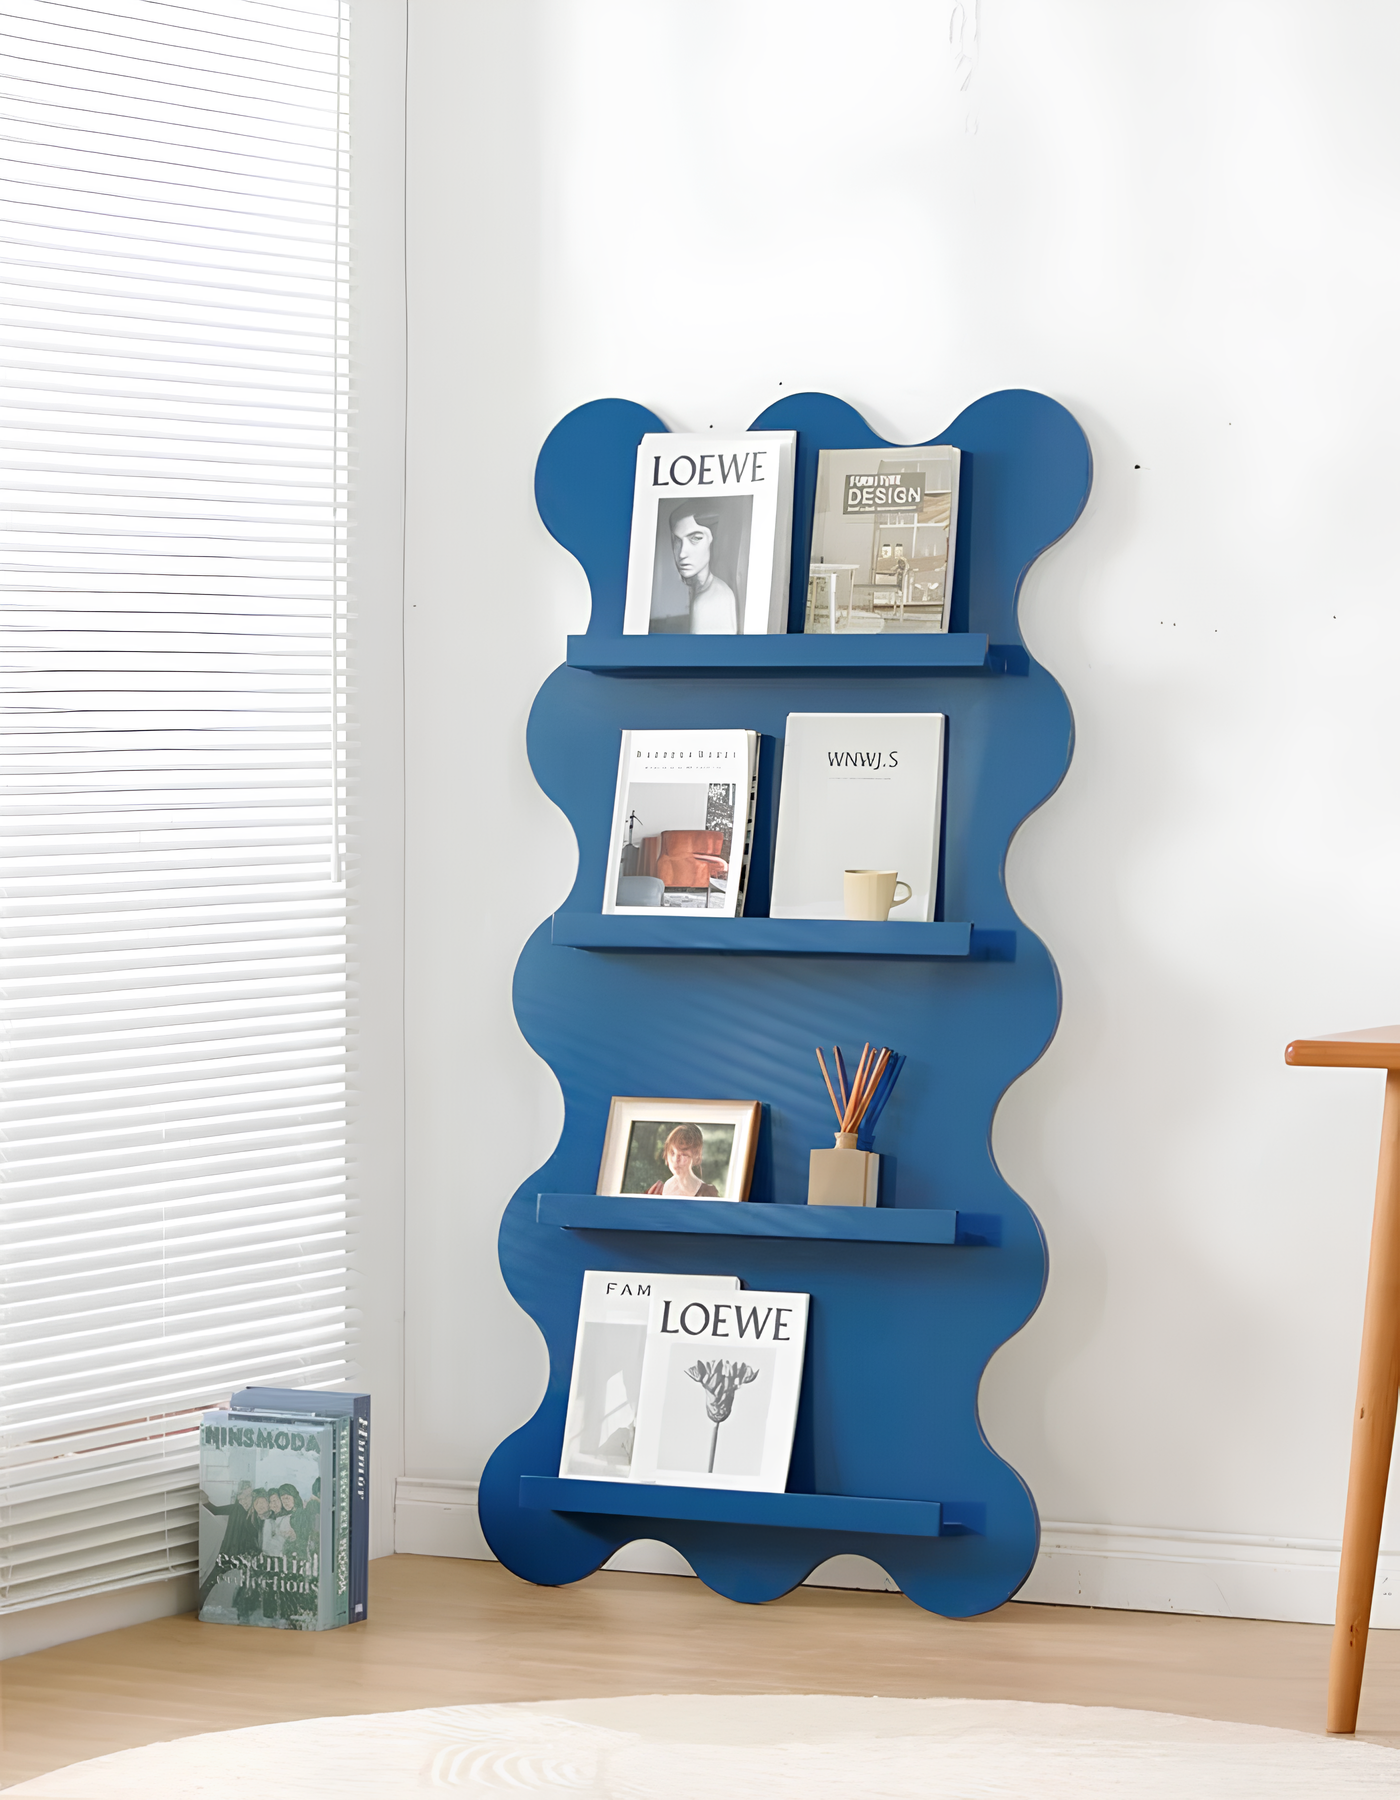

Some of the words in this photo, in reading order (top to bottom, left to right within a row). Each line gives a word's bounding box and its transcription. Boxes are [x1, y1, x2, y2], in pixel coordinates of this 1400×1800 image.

[652, 451, 767, 486] LOEWE
[847, 487, 921, 505] DESIGN
[660, 1300, 793, 1341] LOEWE
